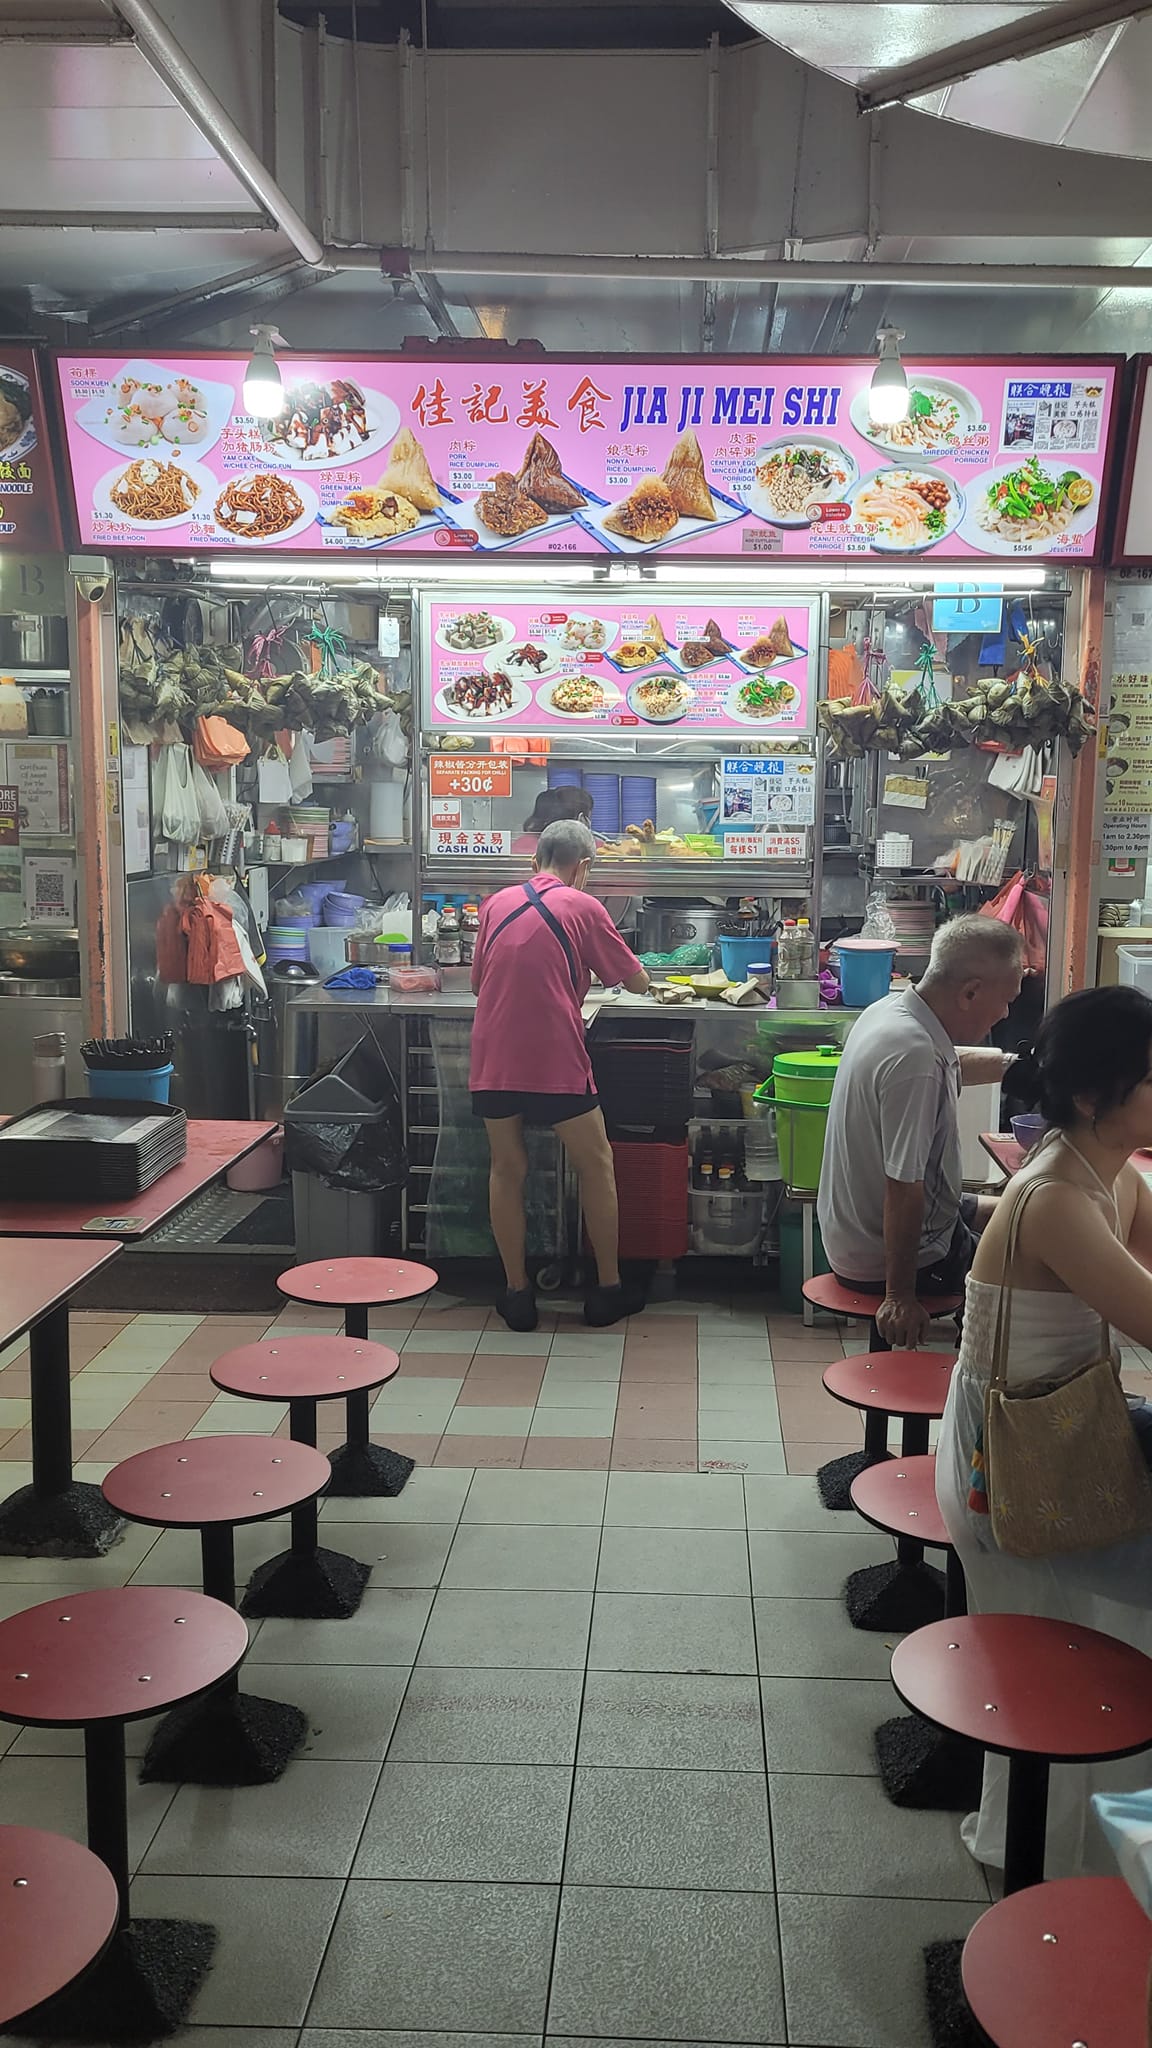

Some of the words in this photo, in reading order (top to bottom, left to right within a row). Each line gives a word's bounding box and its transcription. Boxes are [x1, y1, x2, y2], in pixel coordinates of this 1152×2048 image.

[411, 376, 612, 433] 佳記美食
[620, 386, 668, 432] JIA
[677, 386, 704, 432] JI
[711, 387, 775, 425] MEI
[782, 387, 841, 426] SHI
[967, 423, 987, 432] $3.50
[453, 472, 473, 480] $3.00
[609, 476, 628, 484] $3.00
[0, 483, 32, 493] NOODLE
[452, 482, 472, 490] $4.00
[0, 523, 15, 532] OUP
[324, 538, 344, 546] $4.00
[548, 543, 577, 551] #02-166
[0, 790, 17, 801] ORE
[438, 832, 503, 845] 現金交易
[437, 845, 469, 853] CASH
[473, 845, 503, 853] ONLY
